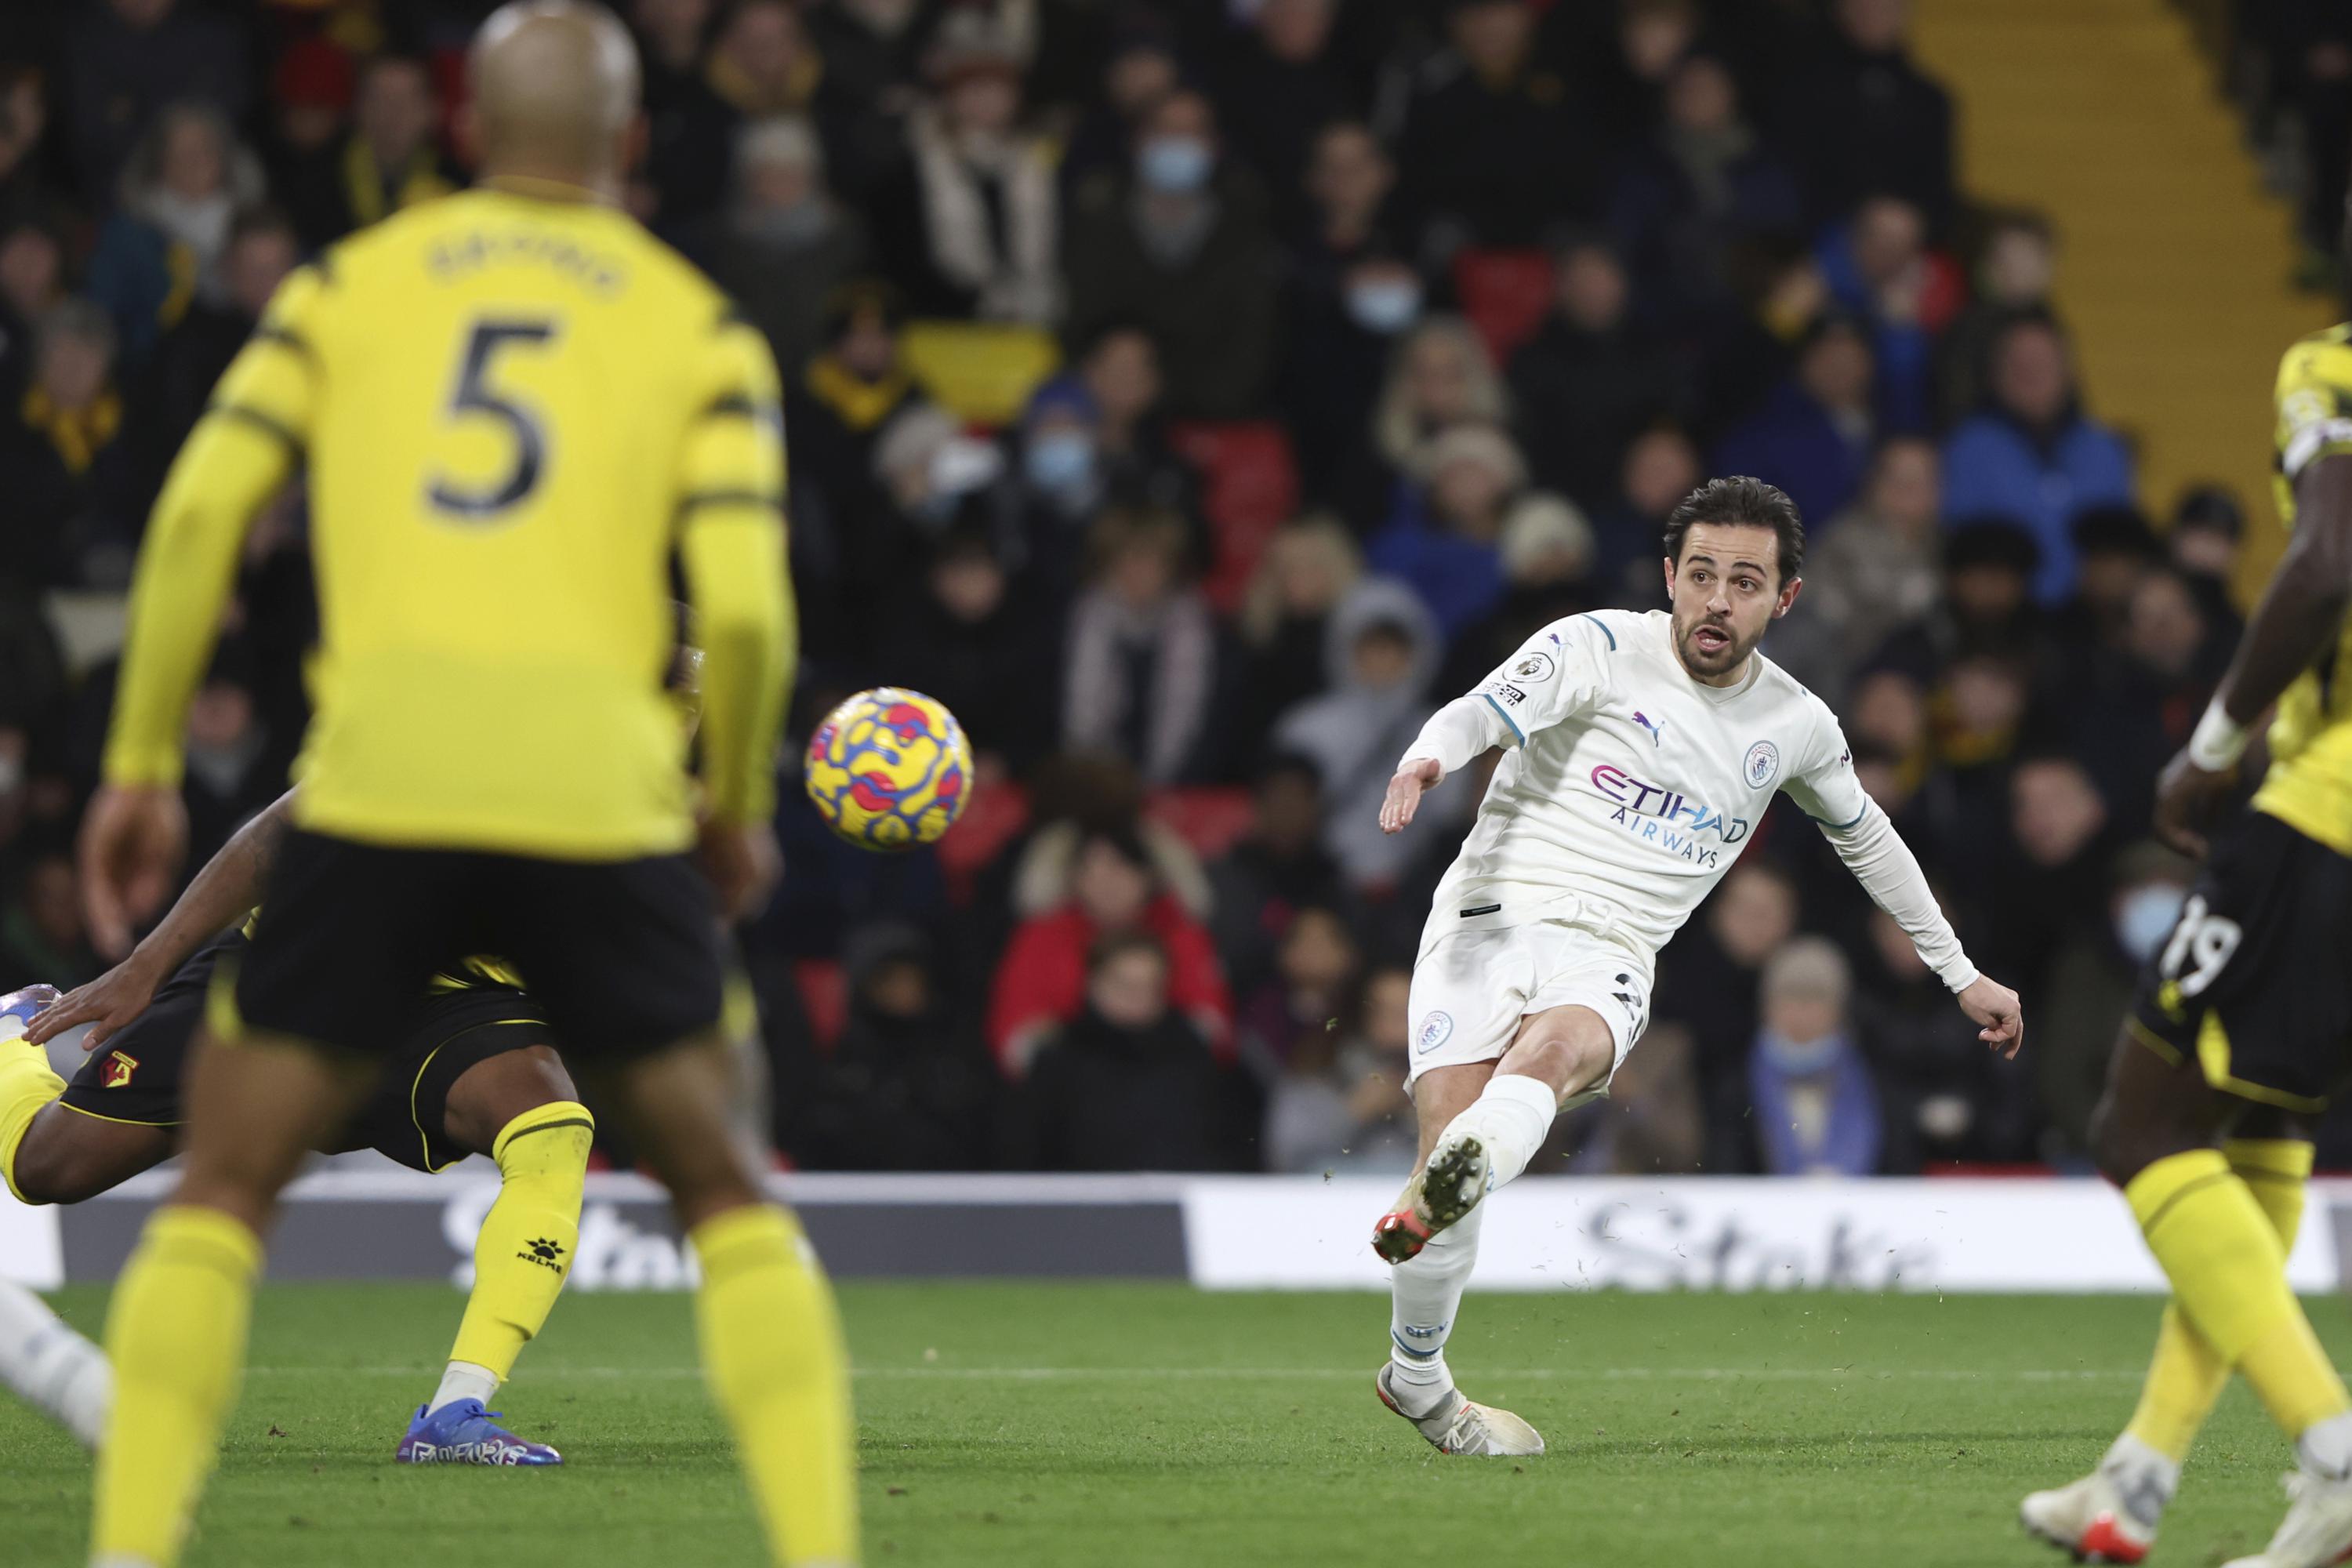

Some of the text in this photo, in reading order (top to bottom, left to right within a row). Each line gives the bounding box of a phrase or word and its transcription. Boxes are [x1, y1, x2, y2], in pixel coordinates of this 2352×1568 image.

[428, 320, 557, 517] 5
[1591, 764, 1748, 844] ETIHAD
[1610, 806, 1718, 869] AIRWAYS
[2158, 893, 2243, 997] 19
[517, 1251, 562, 1274] KELME
